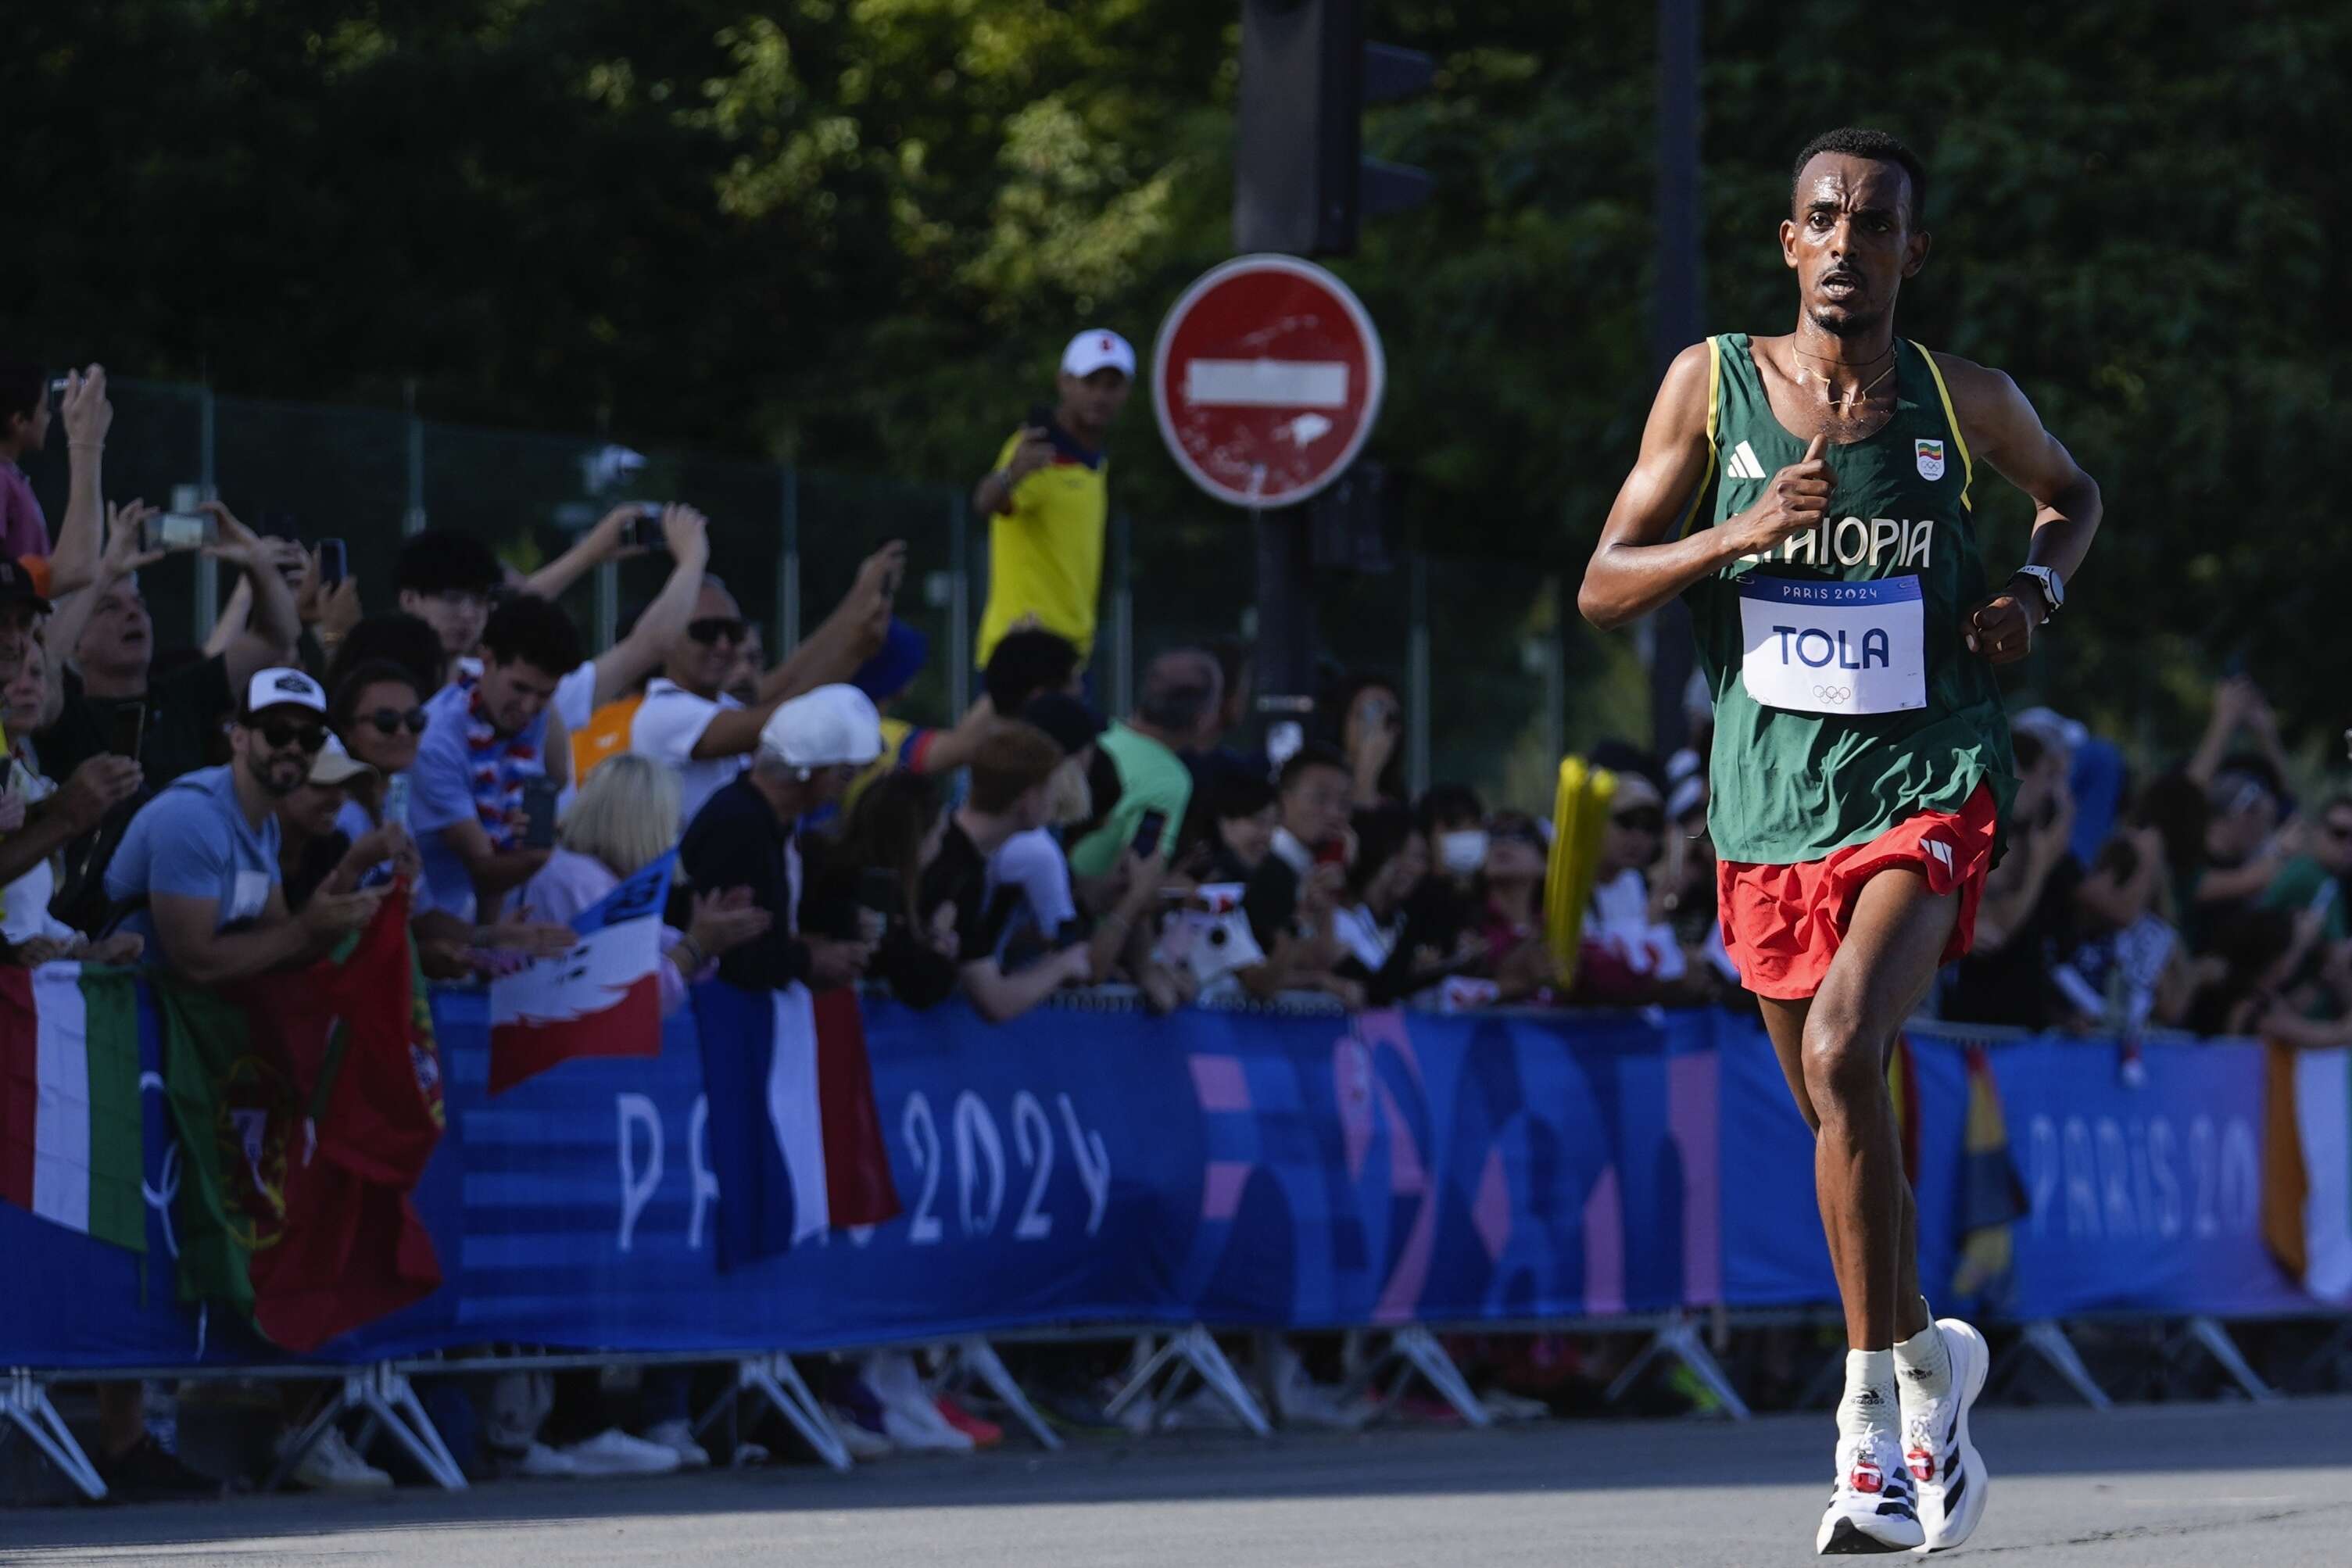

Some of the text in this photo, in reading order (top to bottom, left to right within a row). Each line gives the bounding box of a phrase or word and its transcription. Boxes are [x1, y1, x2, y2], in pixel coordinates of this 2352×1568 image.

[1734, 514, 1934, 568] HIOPIA
[1783, 585, 1878, 600] PARIS 2024
[1772, 625, 1890, 670] TOLA
[901, 1090, 1112, 1244] 2024
[2030, 1115, 2182, 1239] PARIS
